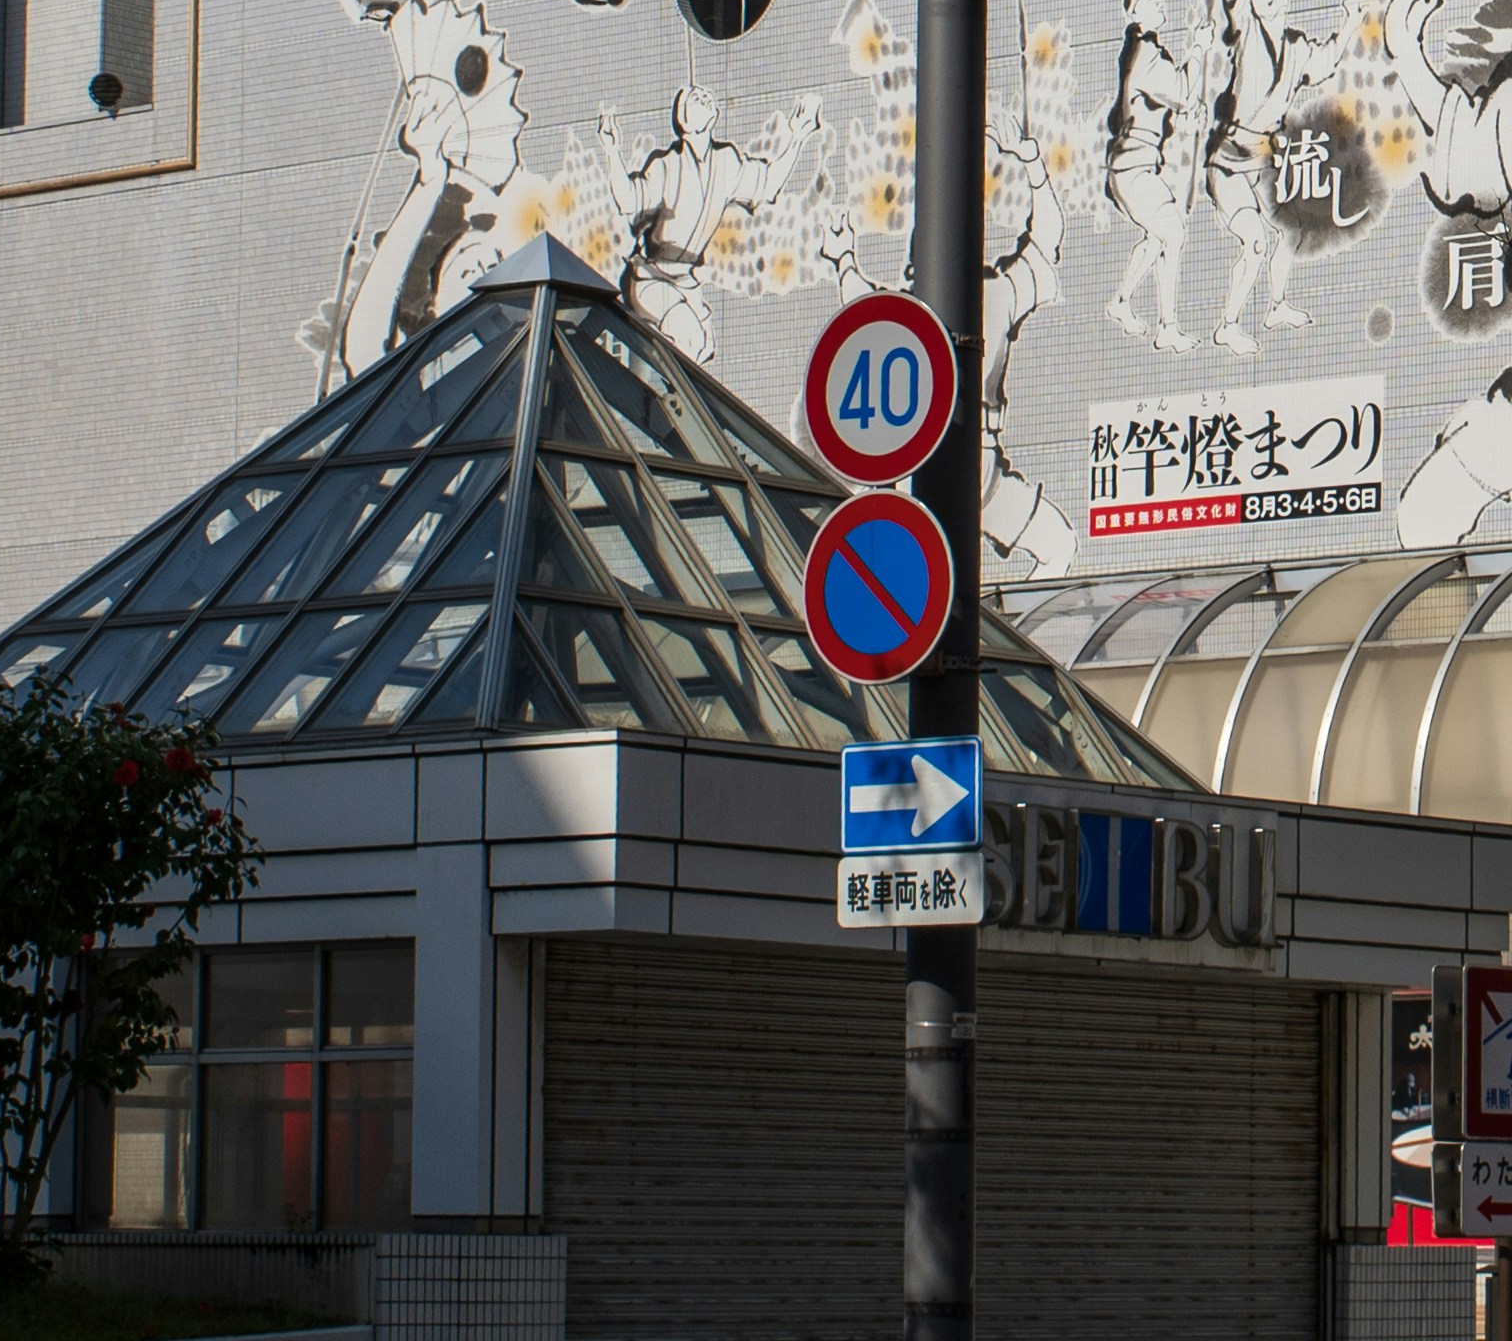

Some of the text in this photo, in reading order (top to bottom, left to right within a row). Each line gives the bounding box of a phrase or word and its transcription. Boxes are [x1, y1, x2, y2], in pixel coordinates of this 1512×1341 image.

[1271, 128, 1368, 228] 流し
[1441, 224, 1511, 313] 肩
[839, 346, 920, 430] 40
[1094, 503, 1238, 531] 国重要無形民俗文化財
[846, 867, 969, 915] 軽車両を除く
